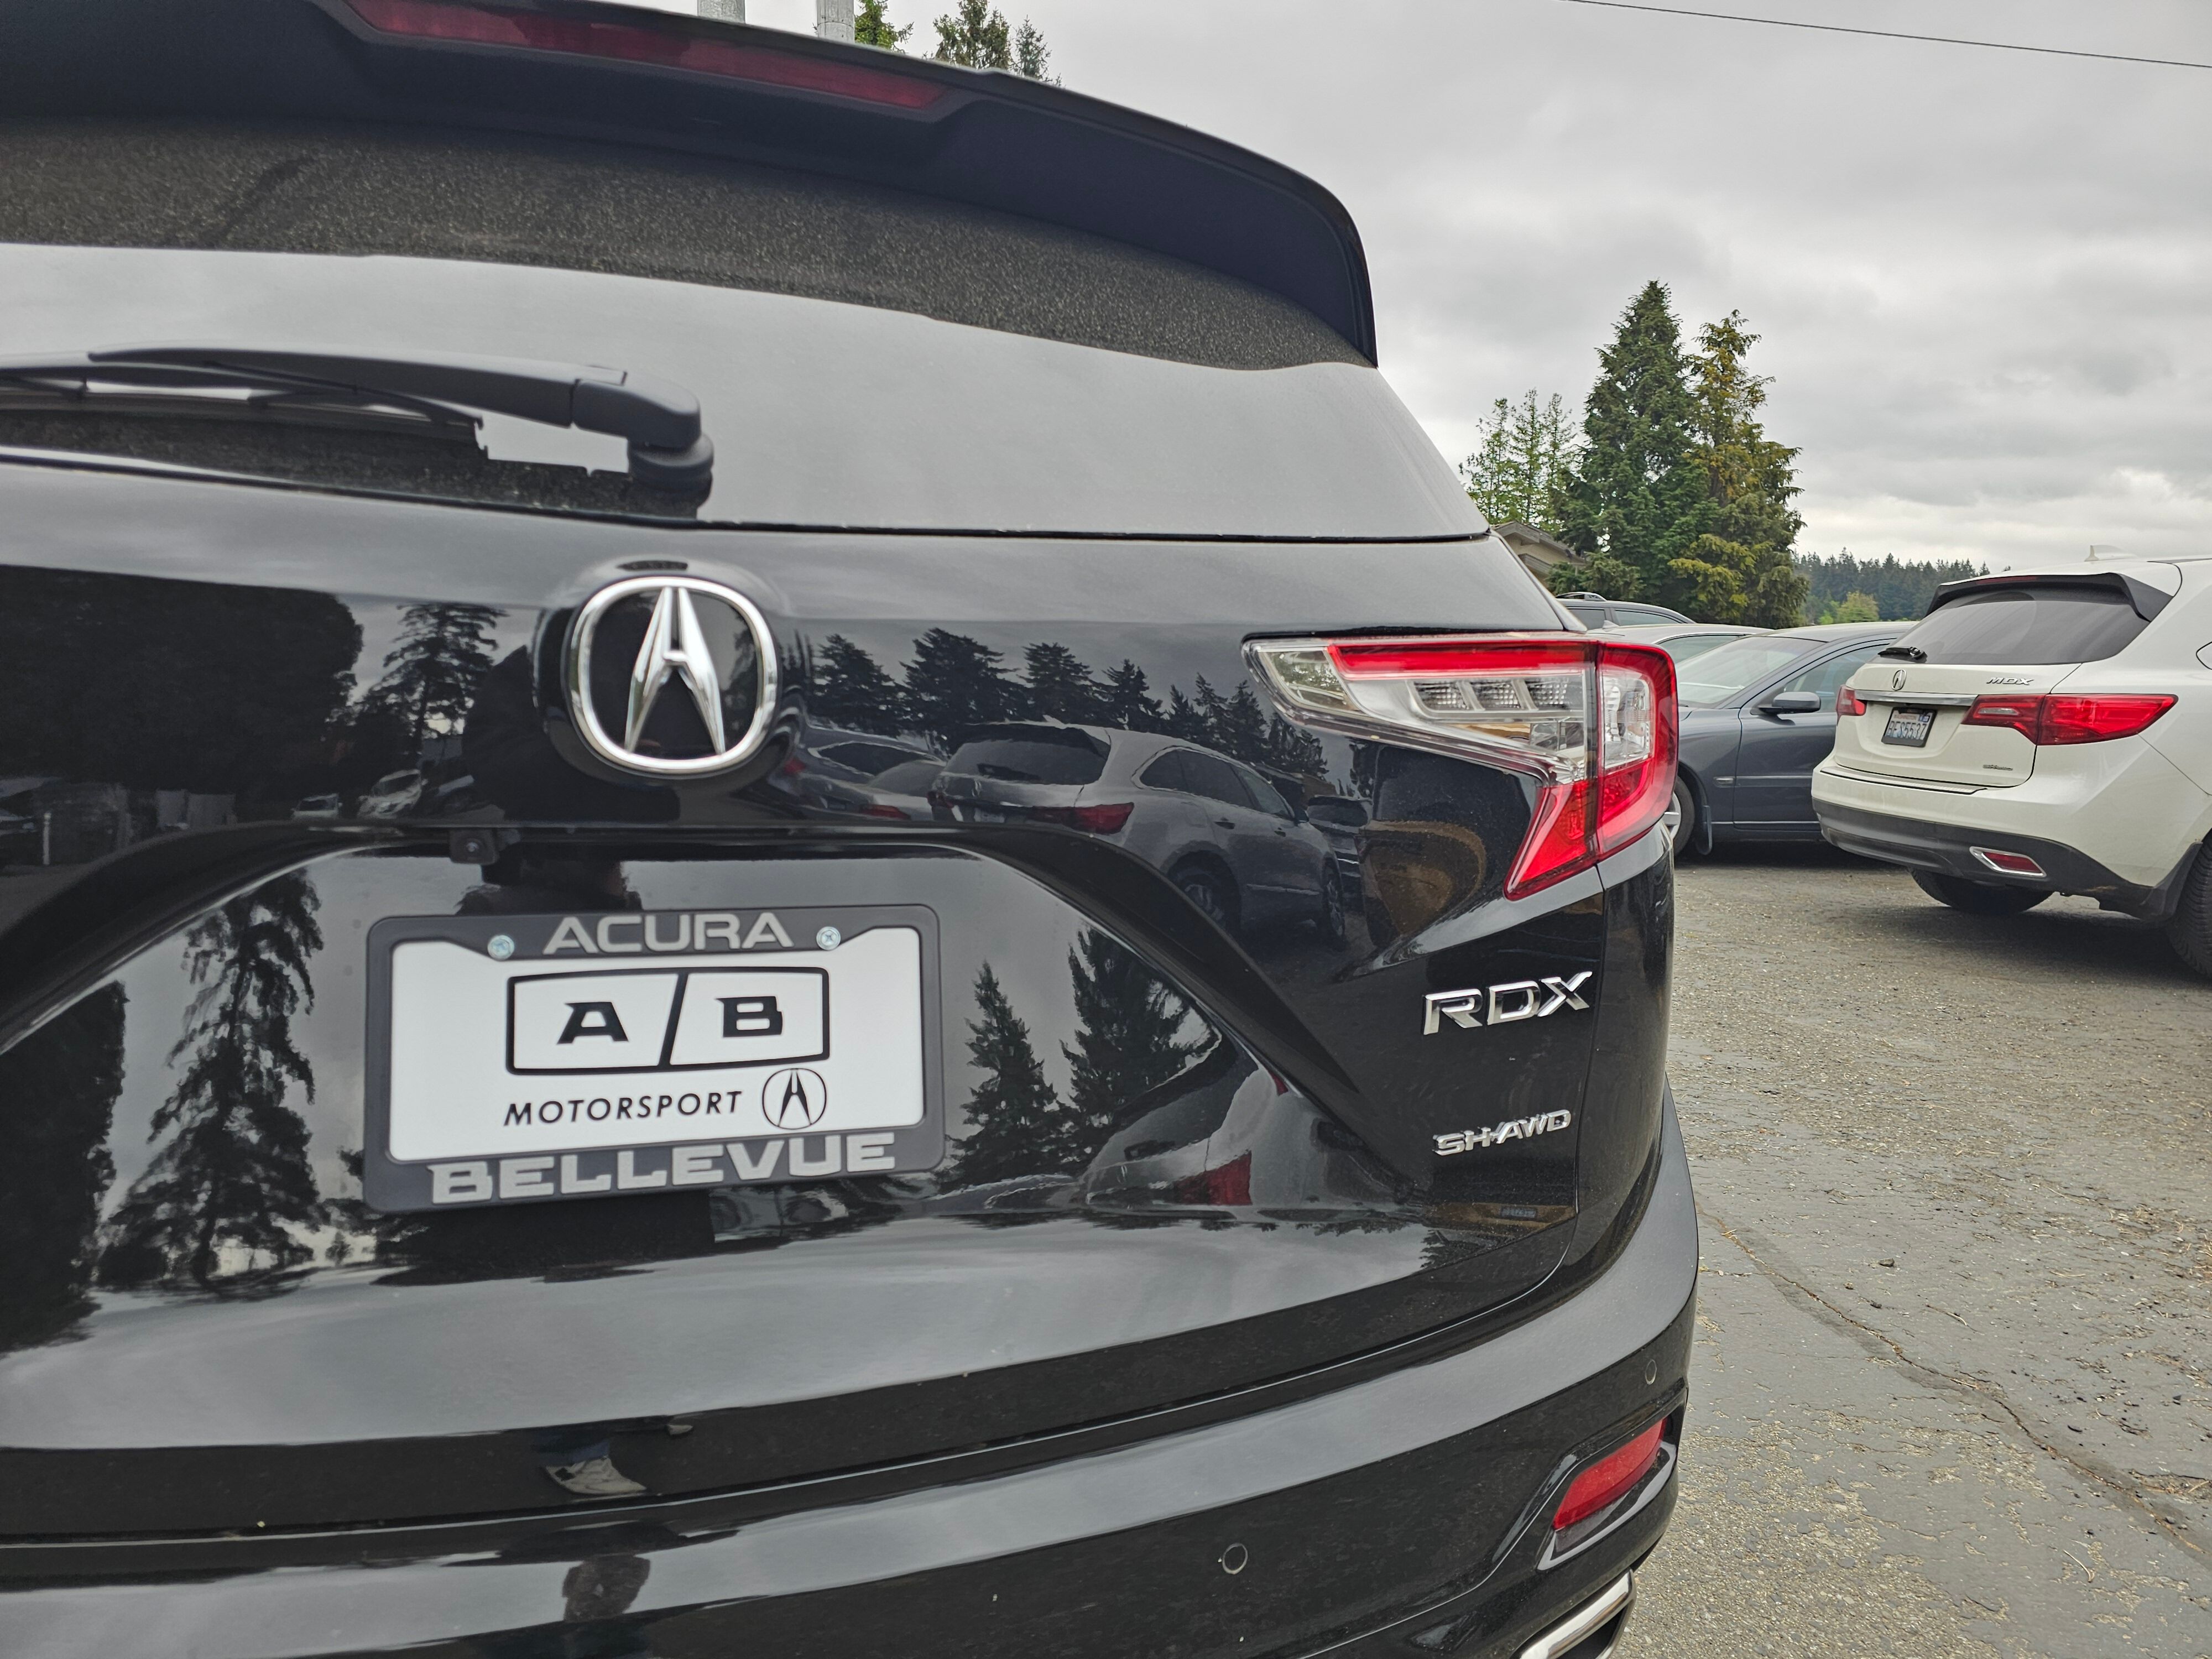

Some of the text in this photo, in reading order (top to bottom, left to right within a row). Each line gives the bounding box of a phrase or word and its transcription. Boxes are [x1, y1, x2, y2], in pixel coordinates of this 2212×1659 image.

[1986, 677, 2034, 685] MDX
[542, 912, 793, 954] ACURA
[557, 995, 783, 1045] A B
[1422, 971, 1593, 1035] RDX
[503, 1091, 743, 1126] MOTORSPORT
[426, 1132, 895, 1204] BELLEVUE
